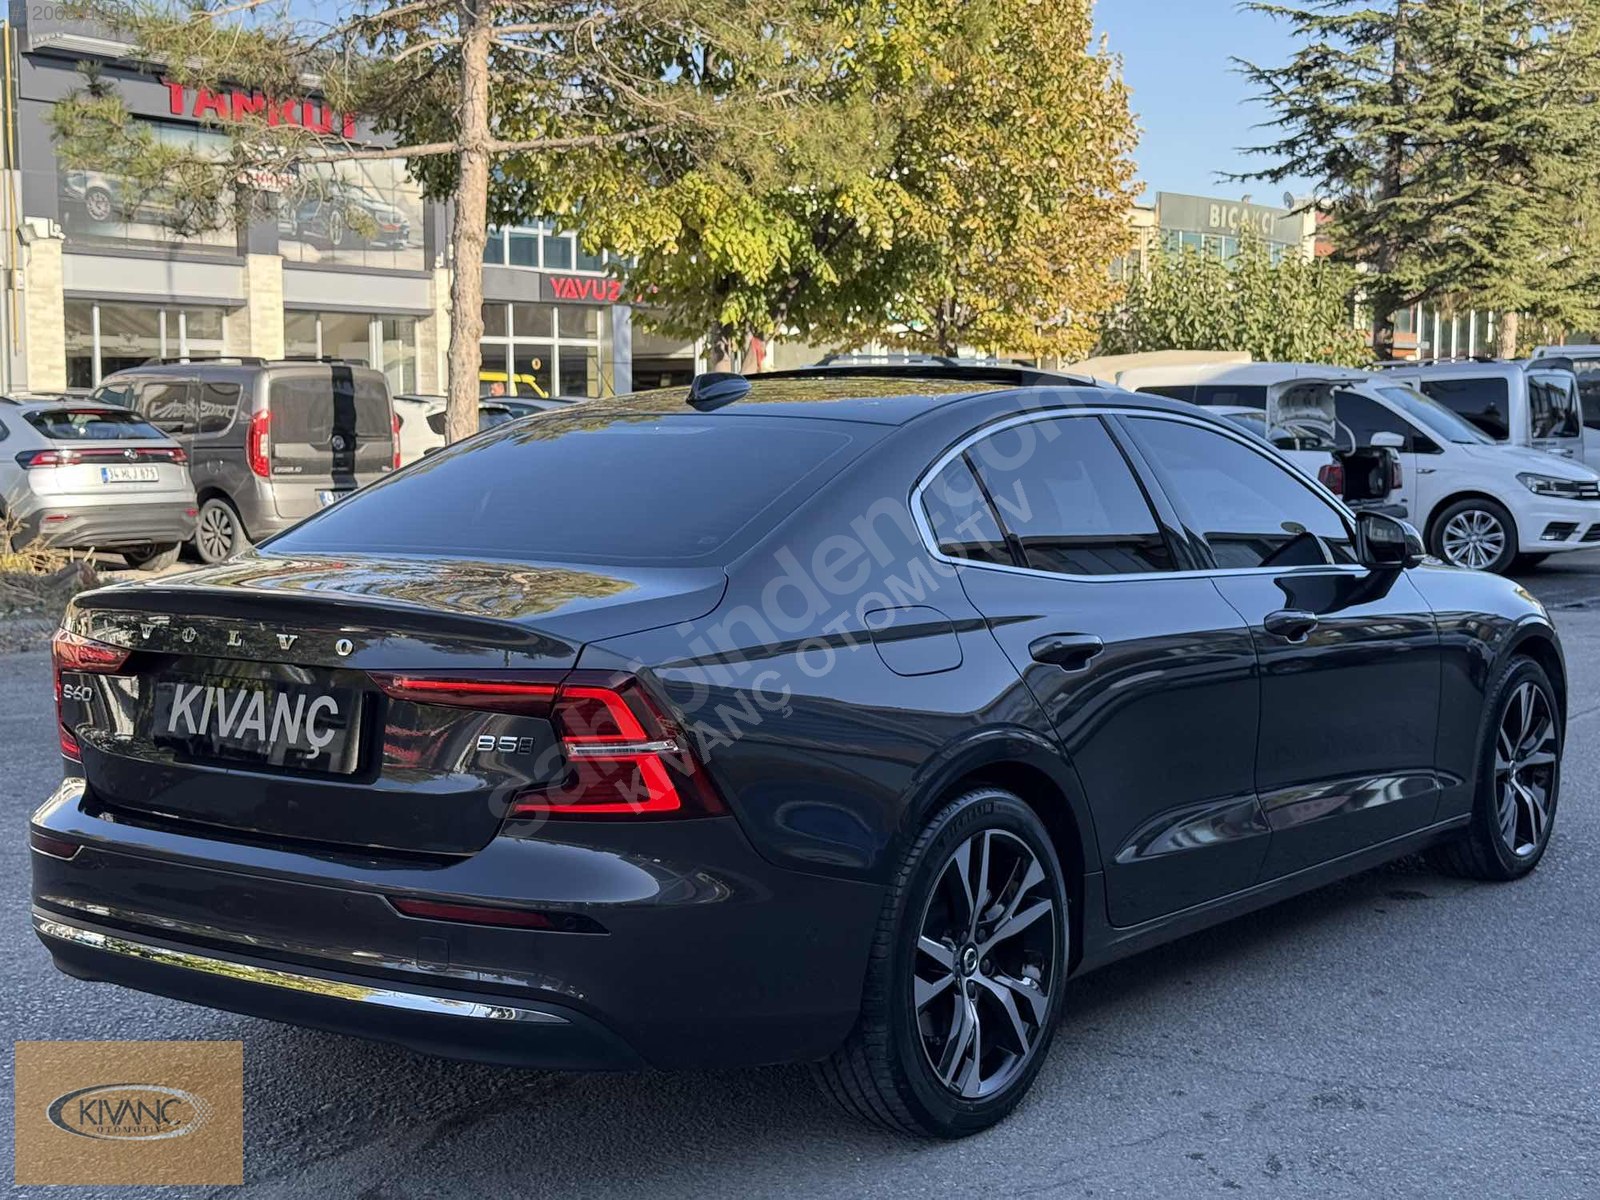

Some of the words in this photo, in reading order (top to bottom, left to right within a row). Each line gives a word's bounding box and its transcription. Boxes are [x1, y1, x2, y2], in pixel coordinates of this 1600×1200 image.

[550, 277, 621, 301] YAVUZ
[141, 623, 353, 656] VOLVO
[63, 684, 93, 702] S60
[168, 684, 339, 760] KIVANÇ
